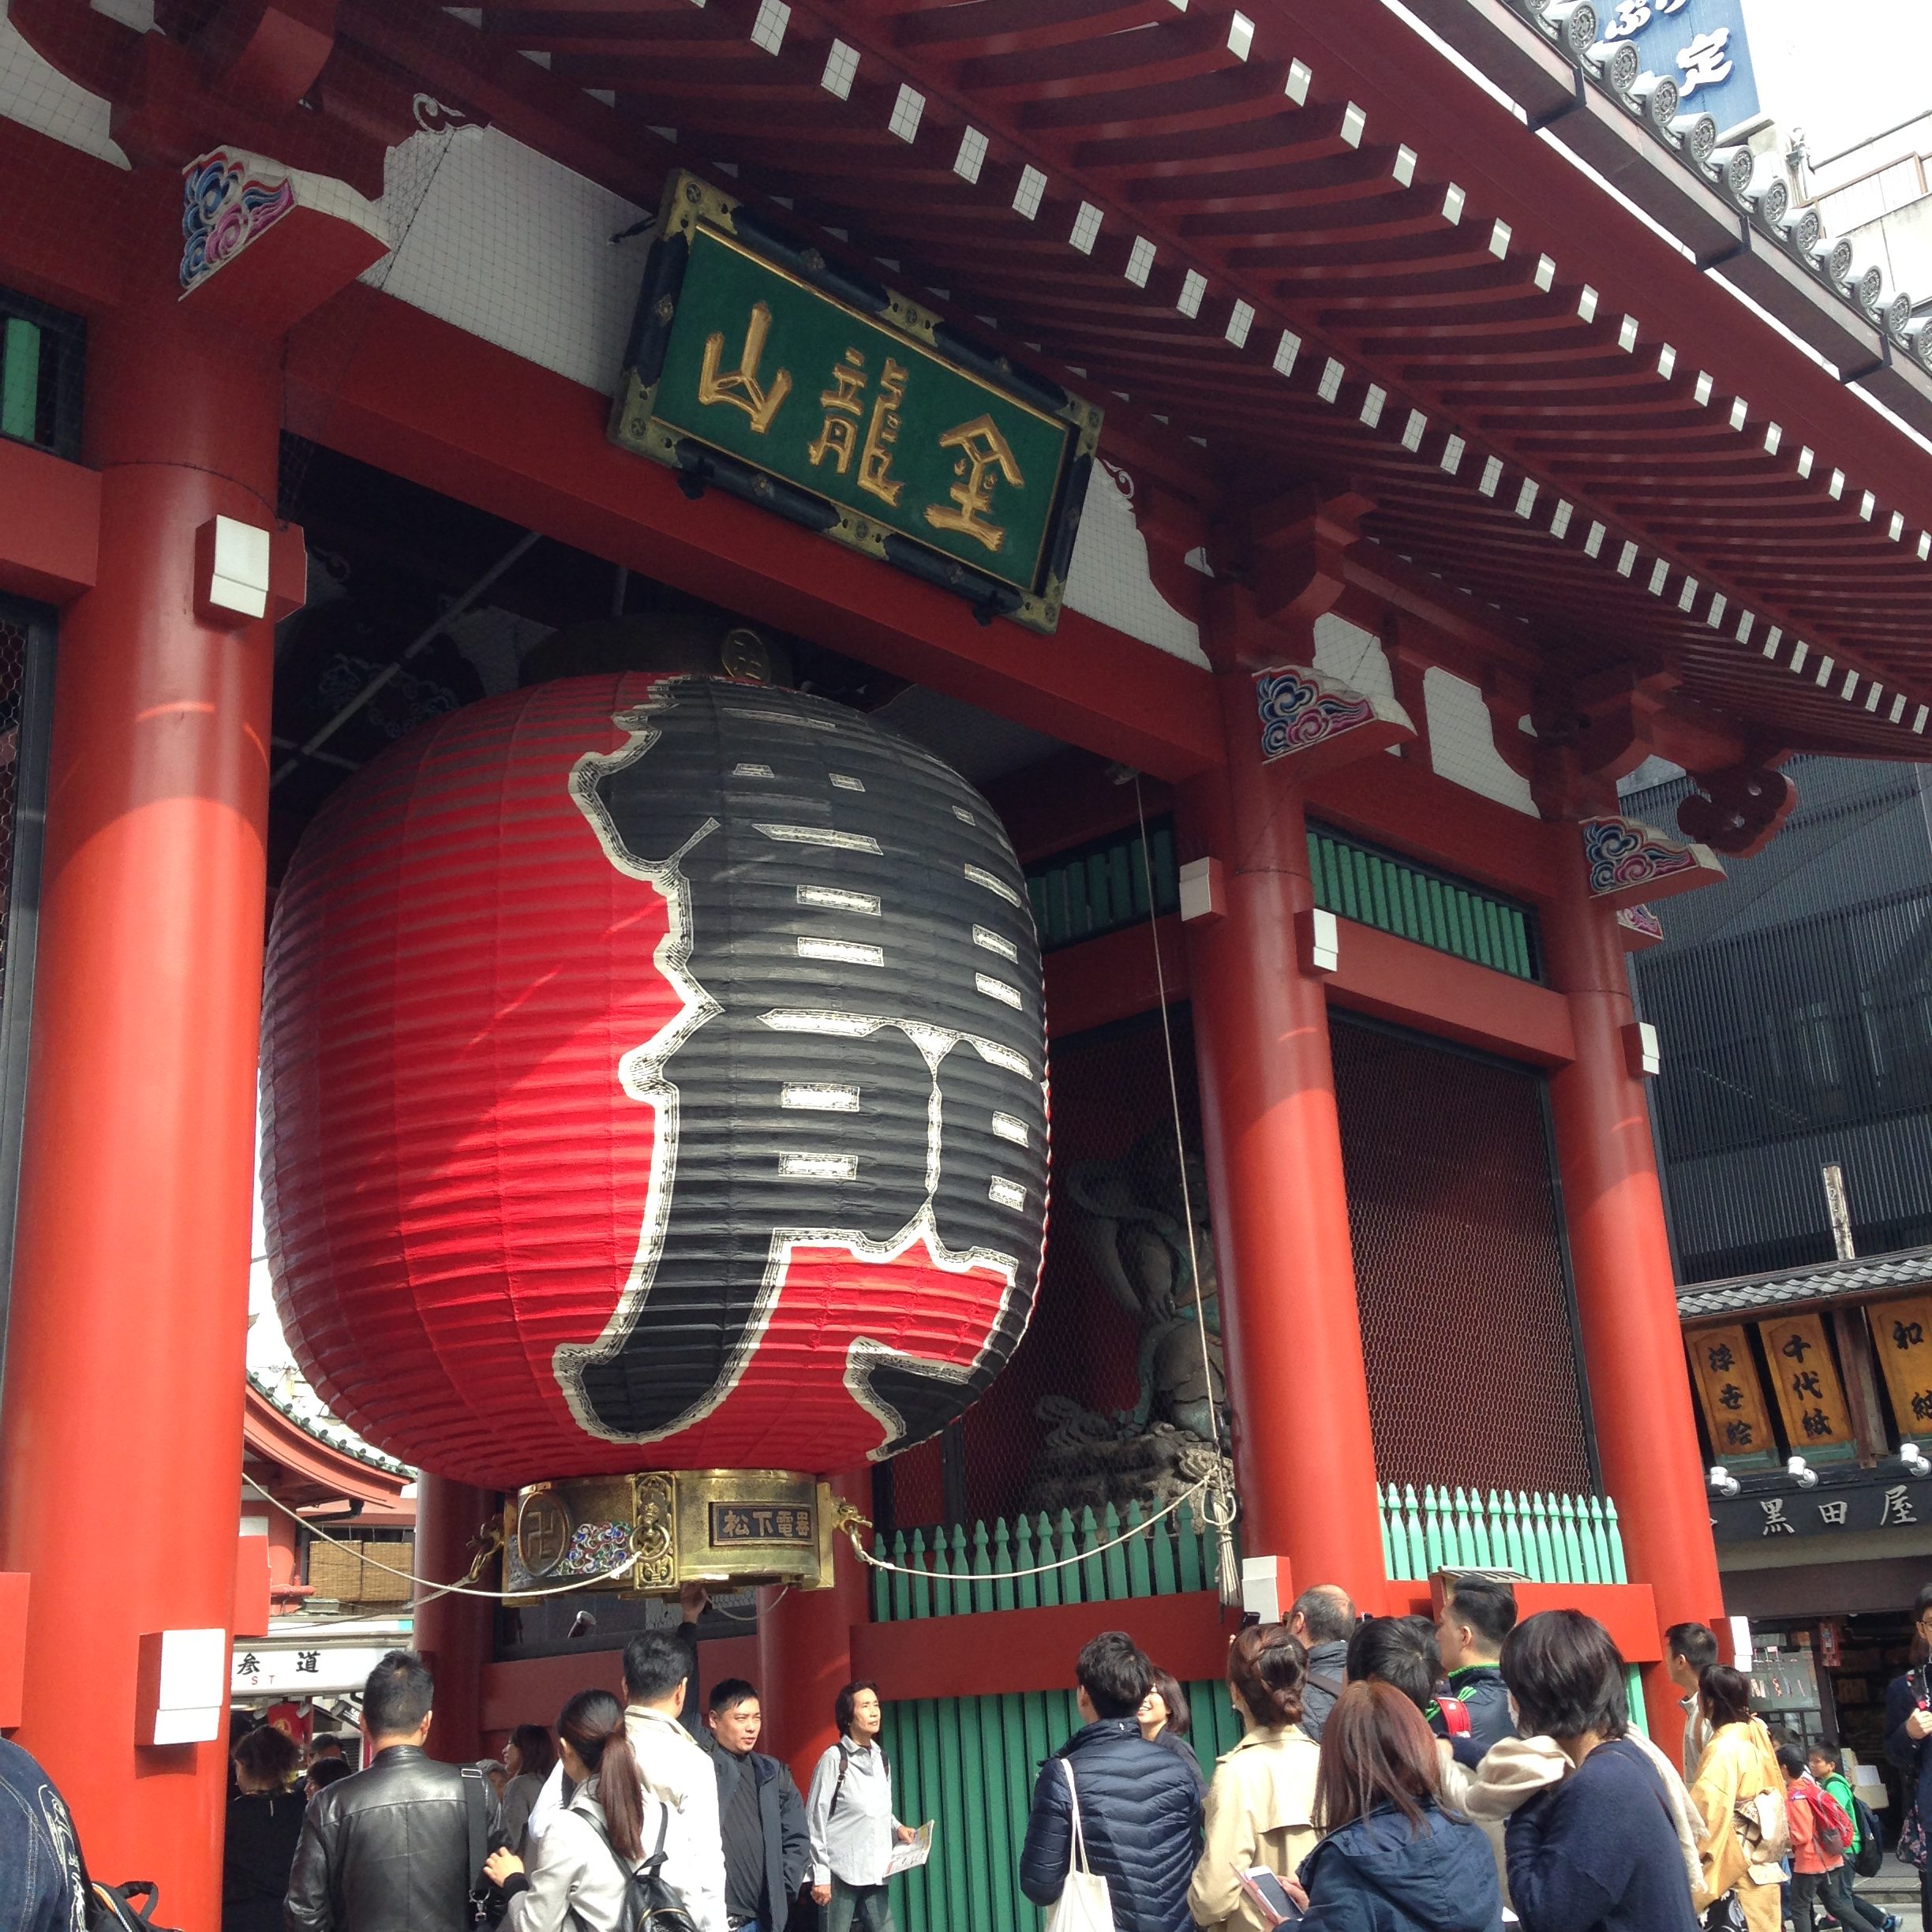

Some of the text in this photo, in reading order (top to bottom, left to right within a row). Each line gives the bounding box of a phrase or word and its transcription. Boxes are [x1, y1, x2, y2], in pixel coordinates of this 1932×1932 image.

[1707, 1342, 1753, 1447] 浮世絵
[1782, 1334, 1832, 1440] 千代紙
[722, 1509, 811, 1537] 松下電器
[1760, 1485, 1918, 1536] 黒田屋
